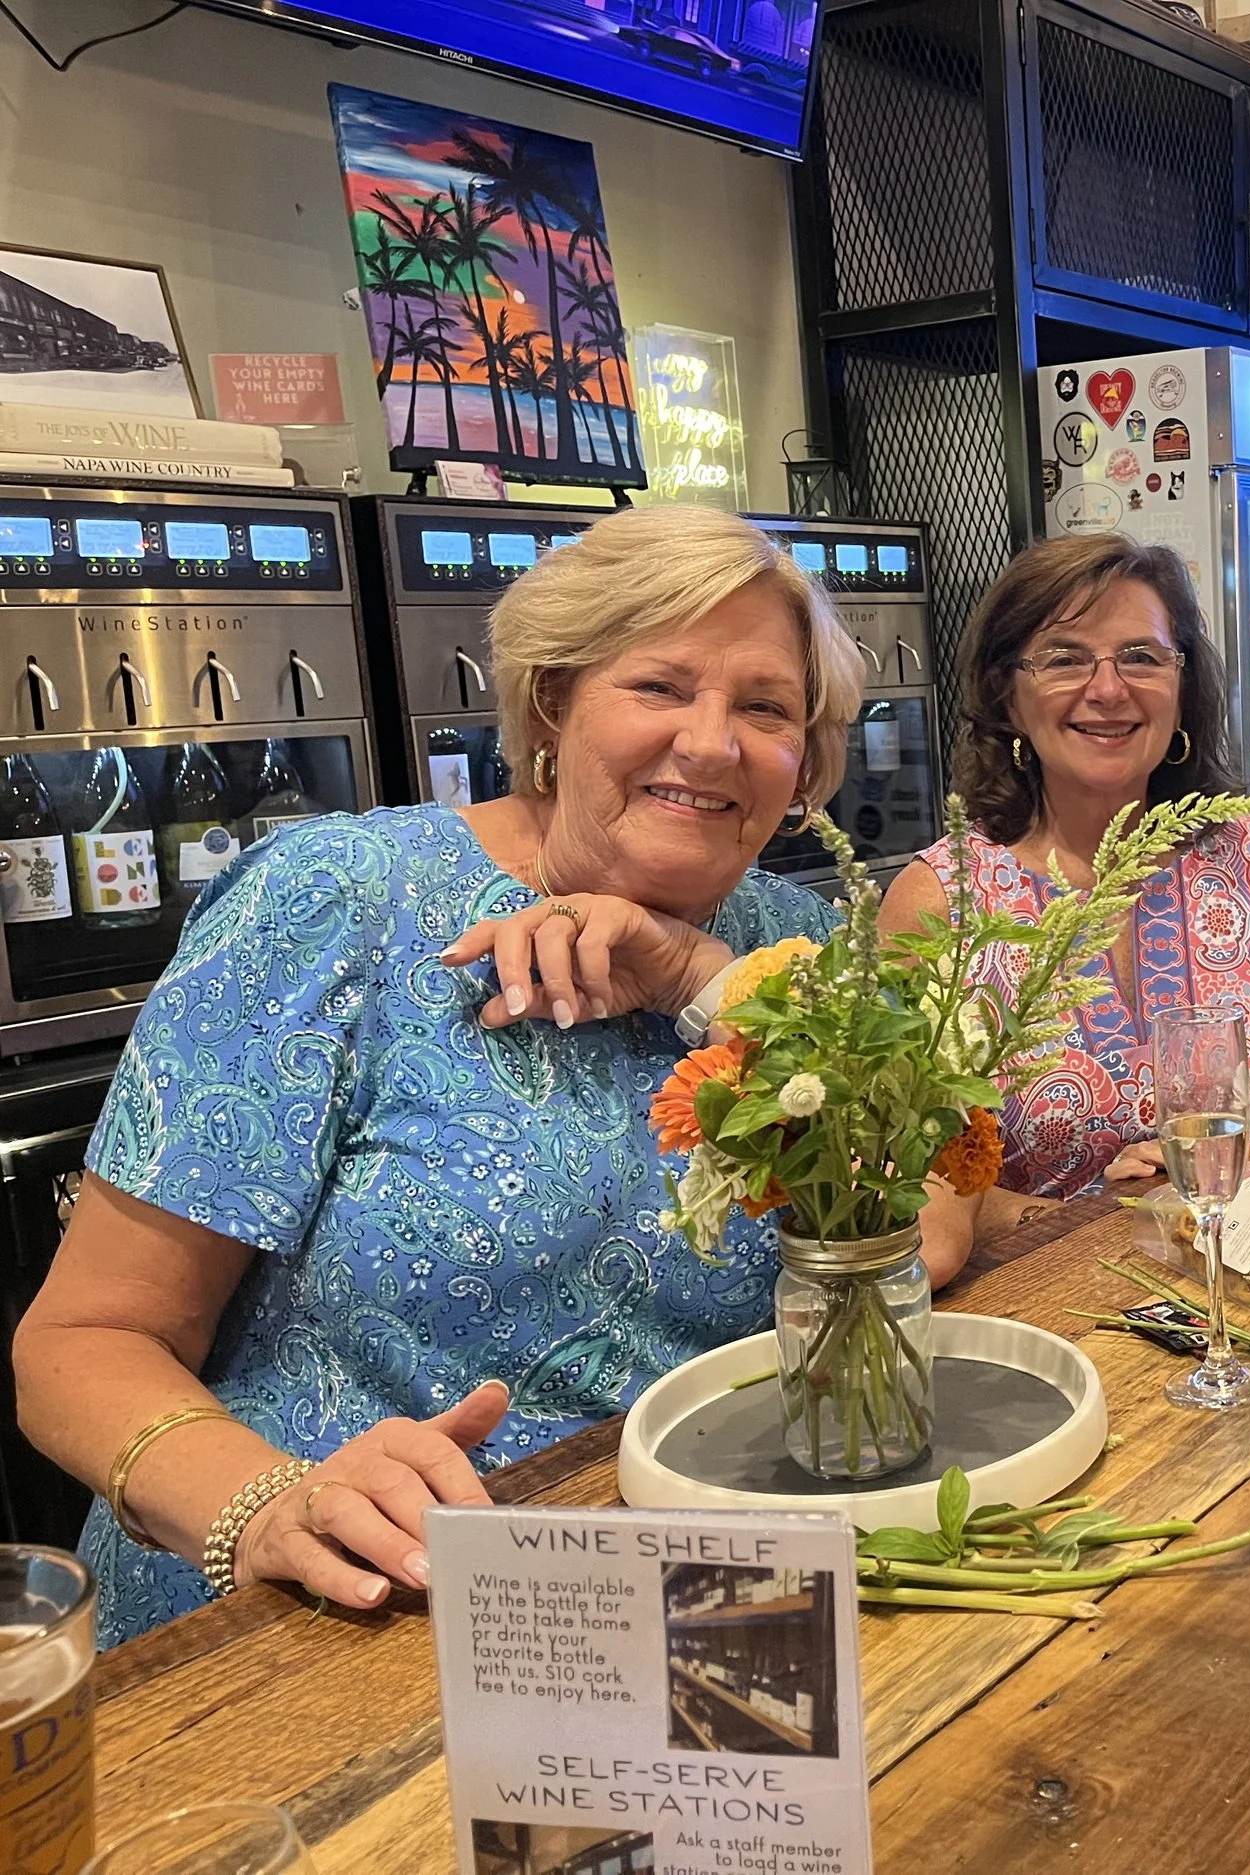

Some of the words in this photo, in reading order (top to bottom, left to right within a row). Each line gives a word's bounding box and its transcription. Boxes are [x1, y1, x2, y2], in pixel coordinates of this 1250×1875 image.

[439, 48, 473, 64] HITACHI
[228, 368, 272, 380] YOUR
[278, 368, 325, 380] EMPTY
[244, 356, 307, 367] RECYCLE
[232, 380, 271, 391] WINE
[277, 380, 325, 391] CARDS
[263, 393, 299, 404] HERE
[656, 384, 730, 448] happy
[37, 422, 62, 434] THE
[64, 424, 91, 438] JOYS
[108, 422, 189, 450] WINE
[63, 458, 107, 472] NAPA
[109, 461, 153, 474] WINE
[158, 463, 232, 478] COUNTRY
[672, 447, 729, 492] place
[507, 1526, 620, 1555] WINE
[637, 1533, 778, 1563] SHELF
[473, 1573, 520, 1590] Wine
[528, 1577, 540, 1591] is
[547, 1576, 634, 1596] available
[469, 1588, 491, 1610] by
[498, 1591, 526, 1608] the
[534, 1591, 588, 1612] bottle
[596, 1595, 621, 1613] for
[470, 1612, 501, 1627] you
[508, 1611, 527, 1625] to
[534, 1610, 574, 1628] take
[581, 1611, 630, 1631] home
[472, 1629, 490, 1641] or
[498, 1625, 543, 1644] drink
[548, 1633, 588, 1650] your
[473, 1640, 544, 1661] favorite
[551, 1647, 605, 1665] bottle
[473, 1660, 510, 1677] with
[517, 1667, 539, 1679] us.
[582, 1667, 623, 1684] cork
[475, 1678, 504, 1693] fee
[511, 1680, 528, 1695] to
[535, 1684, 584, 1704] enjoy
[591, 1683, 636, 1702] here.
[538, 1754, 785, 1792] SELF-SERVE
[496, 1783, 594, 1810] WINE
[608, 1791, 805, 1826] STATIONS
[676, 1830, 704, 1847] Ask
[710, 1838, 720, 1849] a
[727, 1836, 764, 1853] staff
[771, 1840, 842, 1857] member
[715, 1852, 732, 1866] to
[739, 1851, 777, 1870] load
[784, 1860, 795, 1871] a
[801, 1860, 842, 1874] wine
